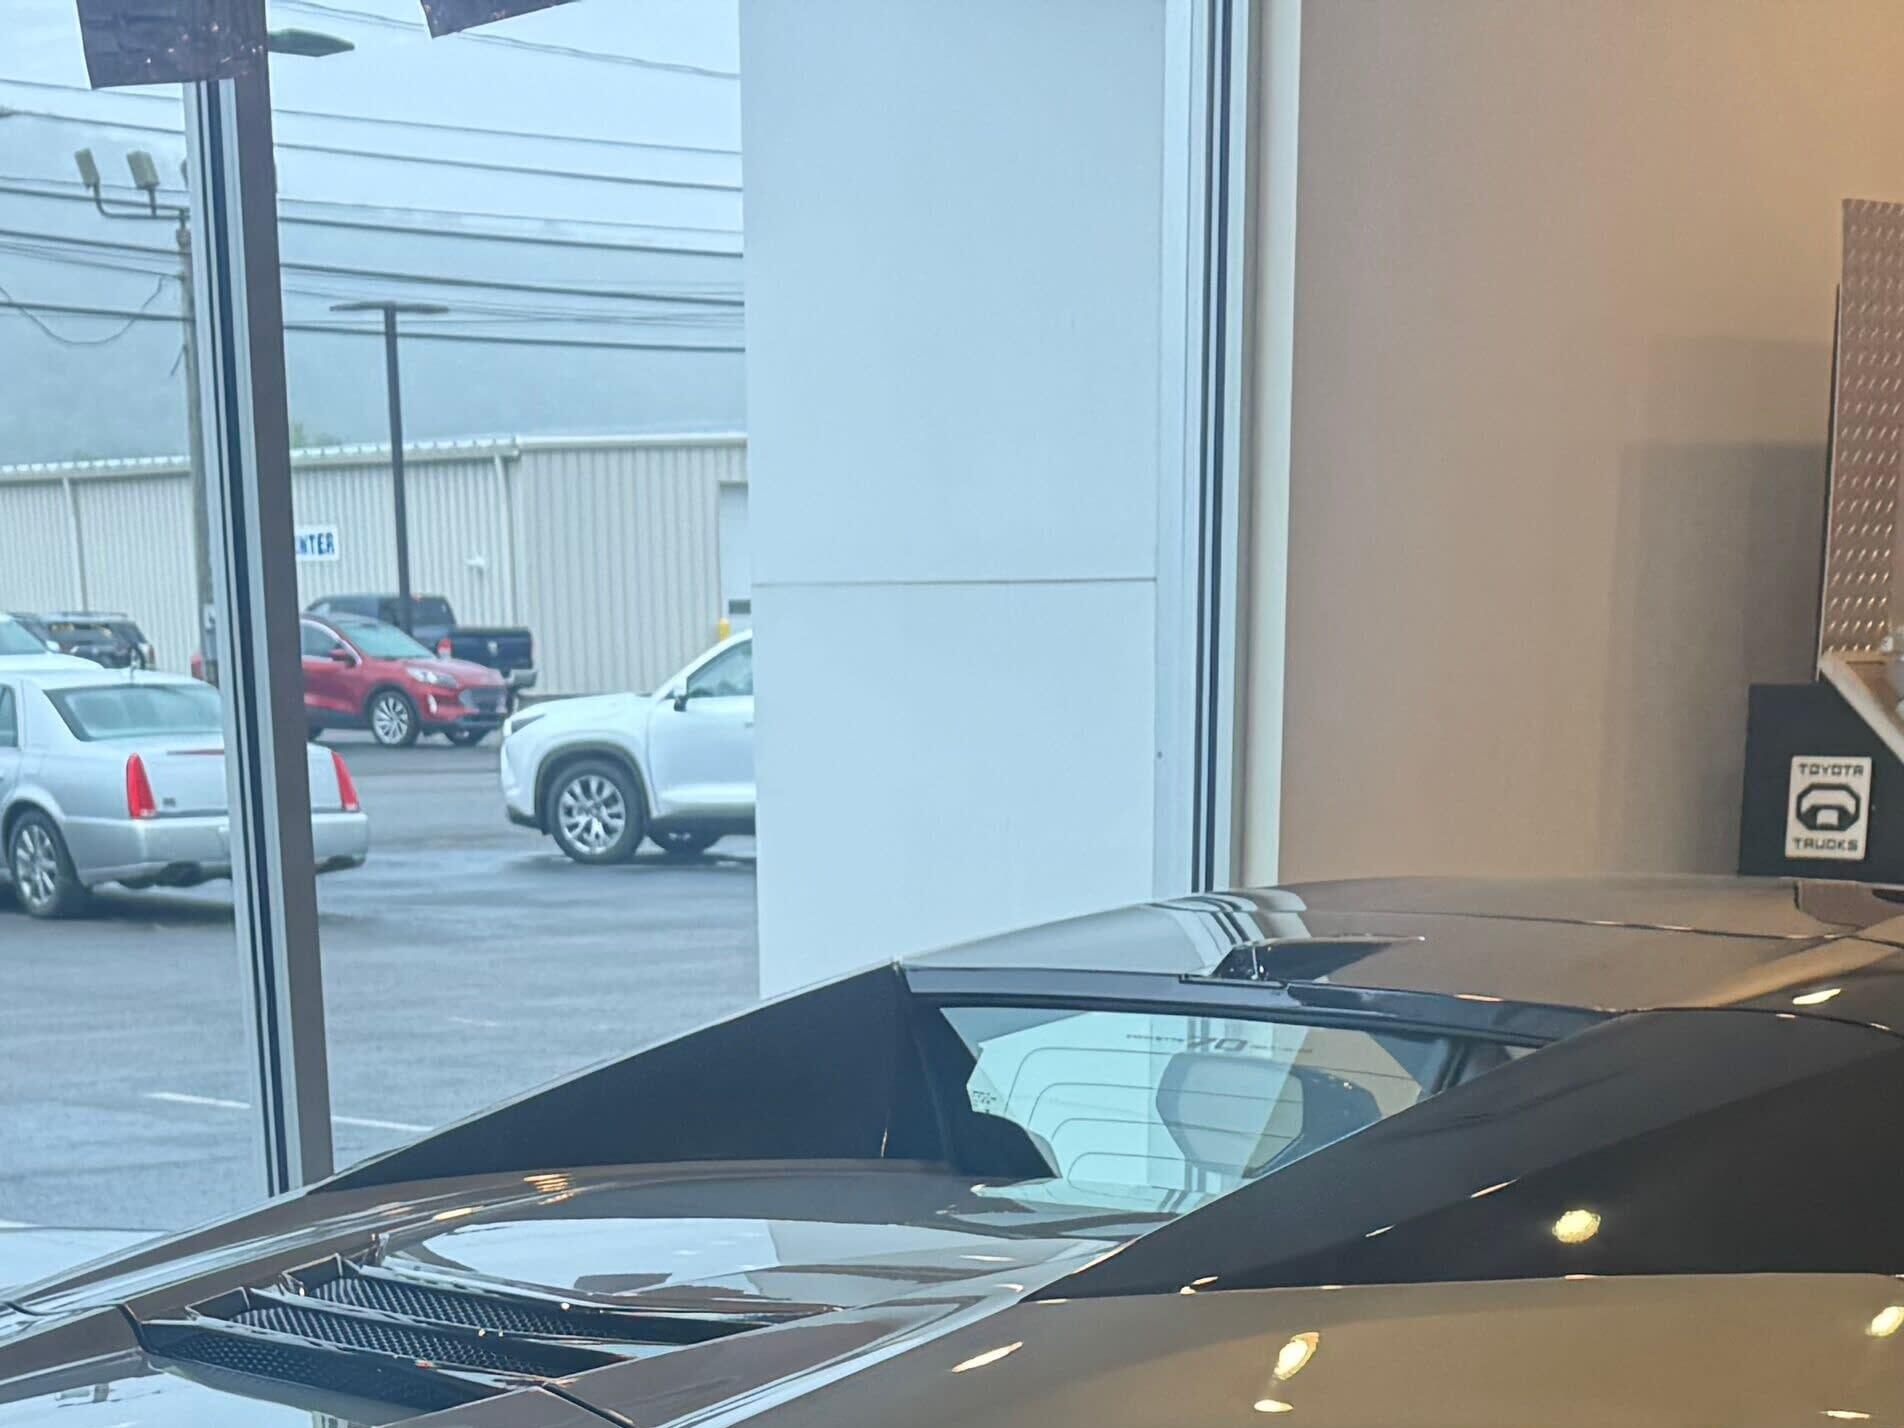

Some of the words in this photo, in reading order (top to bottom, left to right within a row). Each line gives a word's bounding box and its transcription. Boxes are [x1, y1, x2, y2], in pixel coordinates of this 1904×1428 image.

[296, 532, 335, 556] NTER
[1798, 763, 1864, 776] TOYOTA
[1792, 838, 1858, 851] TRUCKS
